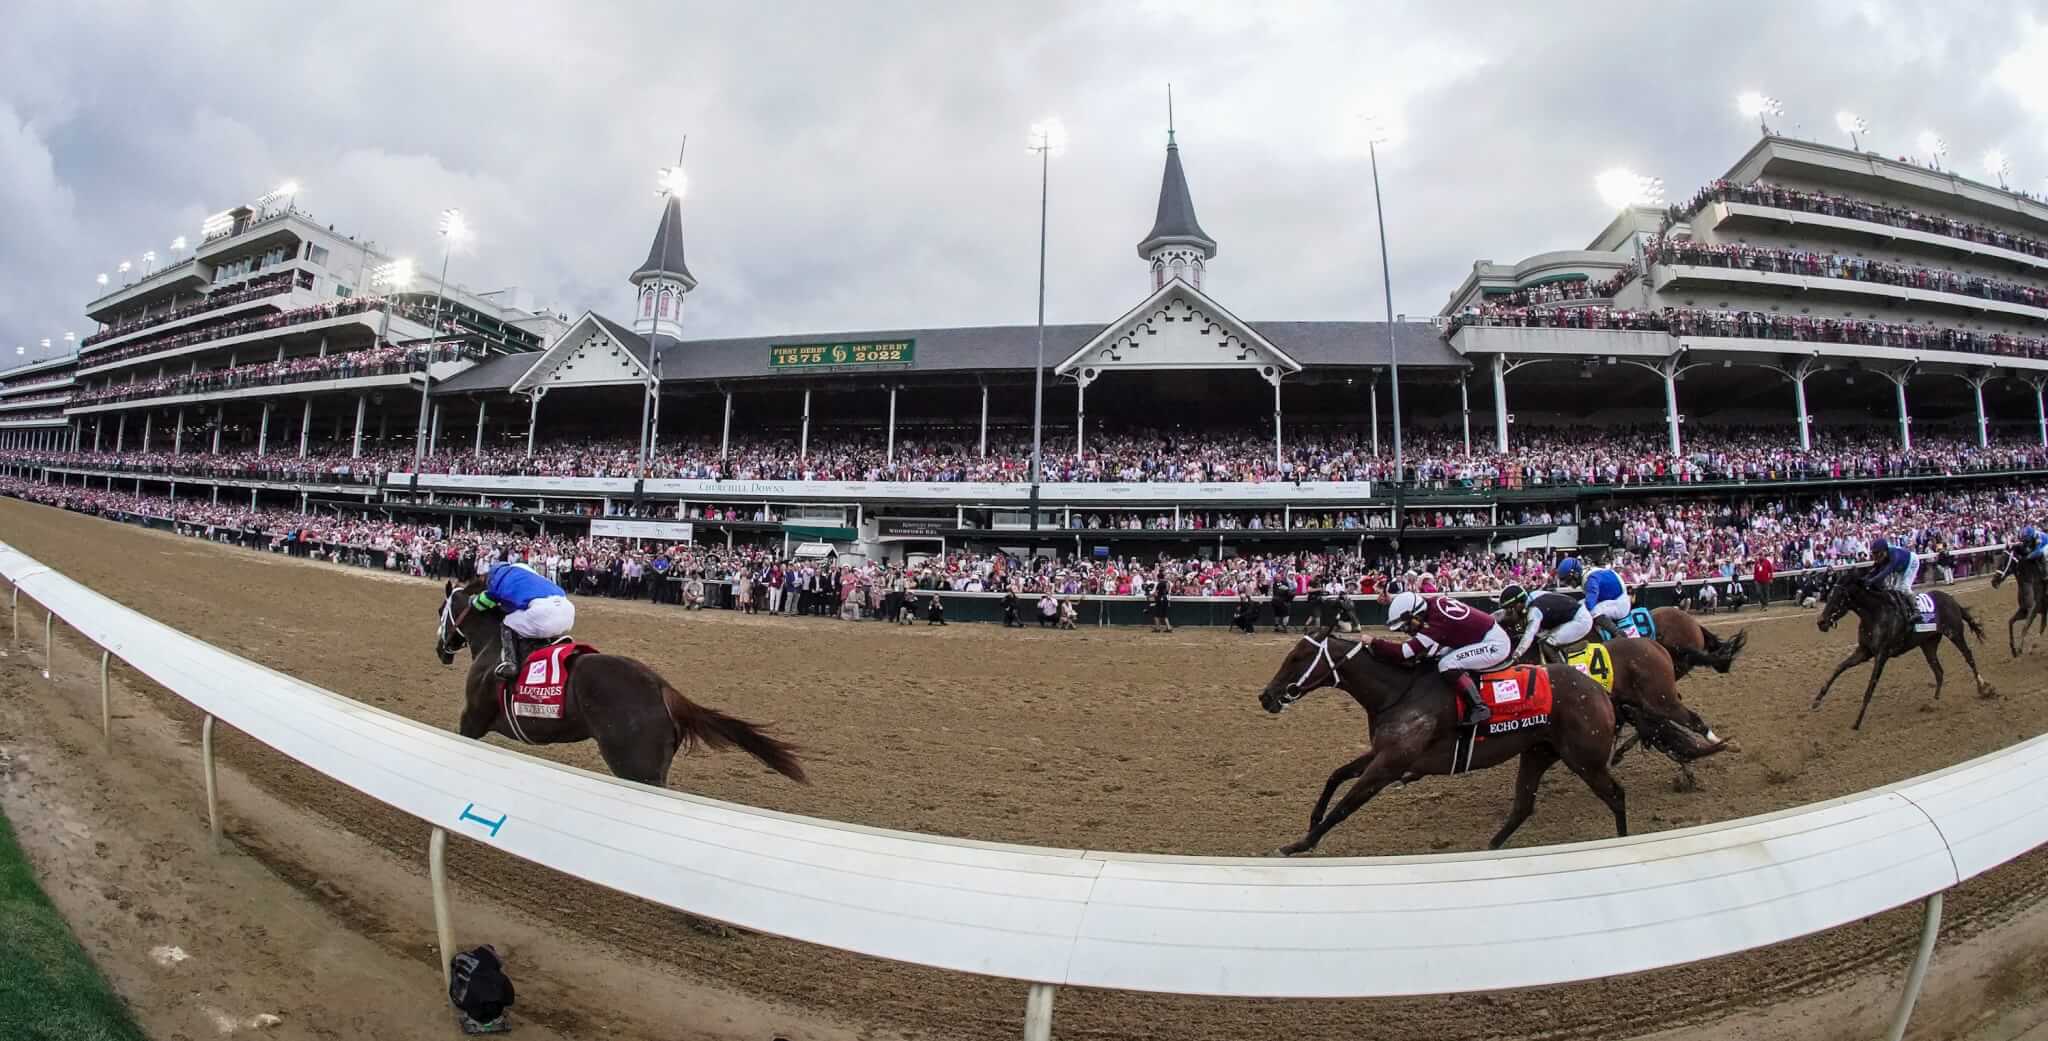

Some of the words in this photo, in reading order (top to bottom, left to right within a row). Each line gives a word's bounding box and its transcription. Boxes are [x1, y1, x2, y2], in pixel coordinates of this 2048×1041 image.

[801, 346, 828, 354] DERBY
[875, 343, 908, 351] DERBY
[778, 353, 821, 364] 1875
[855, 350, 901, 362] 2022
[1631, 611, 1651, 637] 9
[1455, 645, 1490, 661] SENTIENT
[1589, 647, 1609, 680] 4
[1489, 720, 1520, 734] ECHO
[1521, 714, 1549, 728] ZULU
